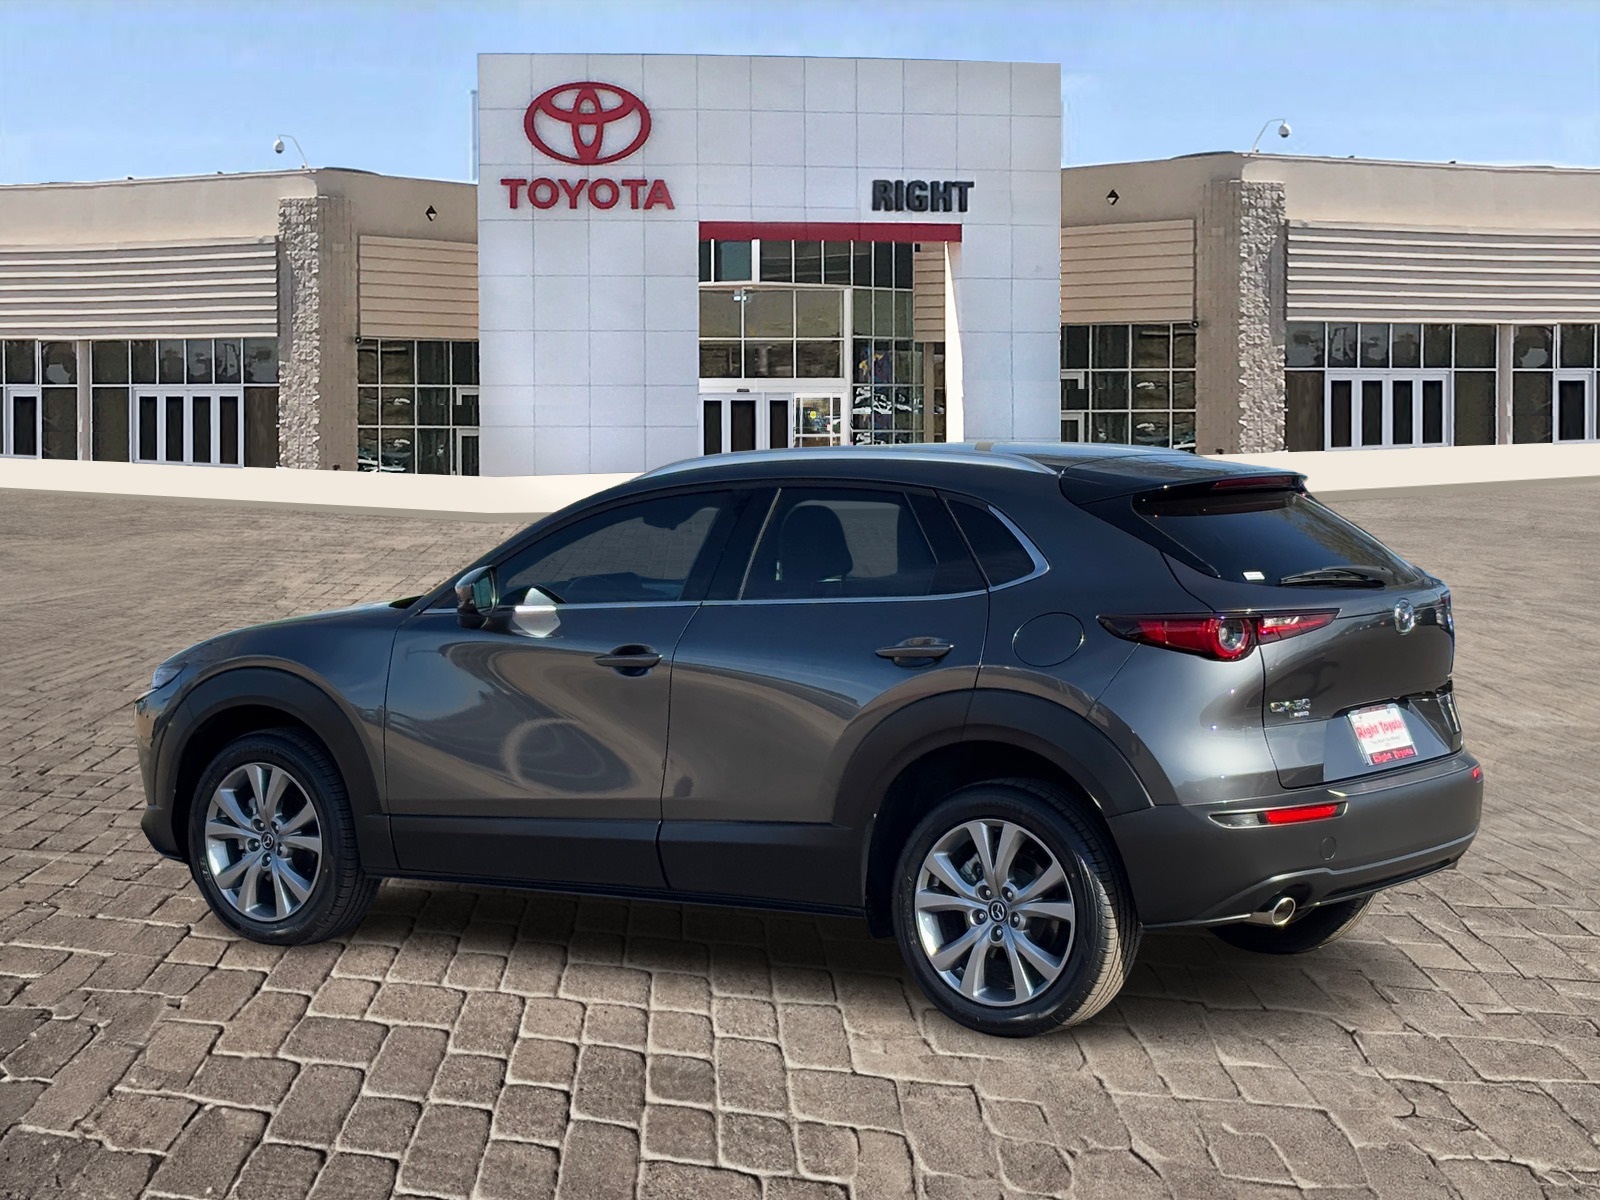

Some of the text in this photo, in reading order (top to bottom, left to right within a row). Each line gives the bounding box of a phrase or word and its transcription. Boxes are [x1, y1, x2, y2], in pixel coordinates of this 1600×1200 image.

[500, 177, 676, 210] TOYOTA
[871, 179, 975, 212] RIGHT
[1355, 724, 1379, 739] Right
